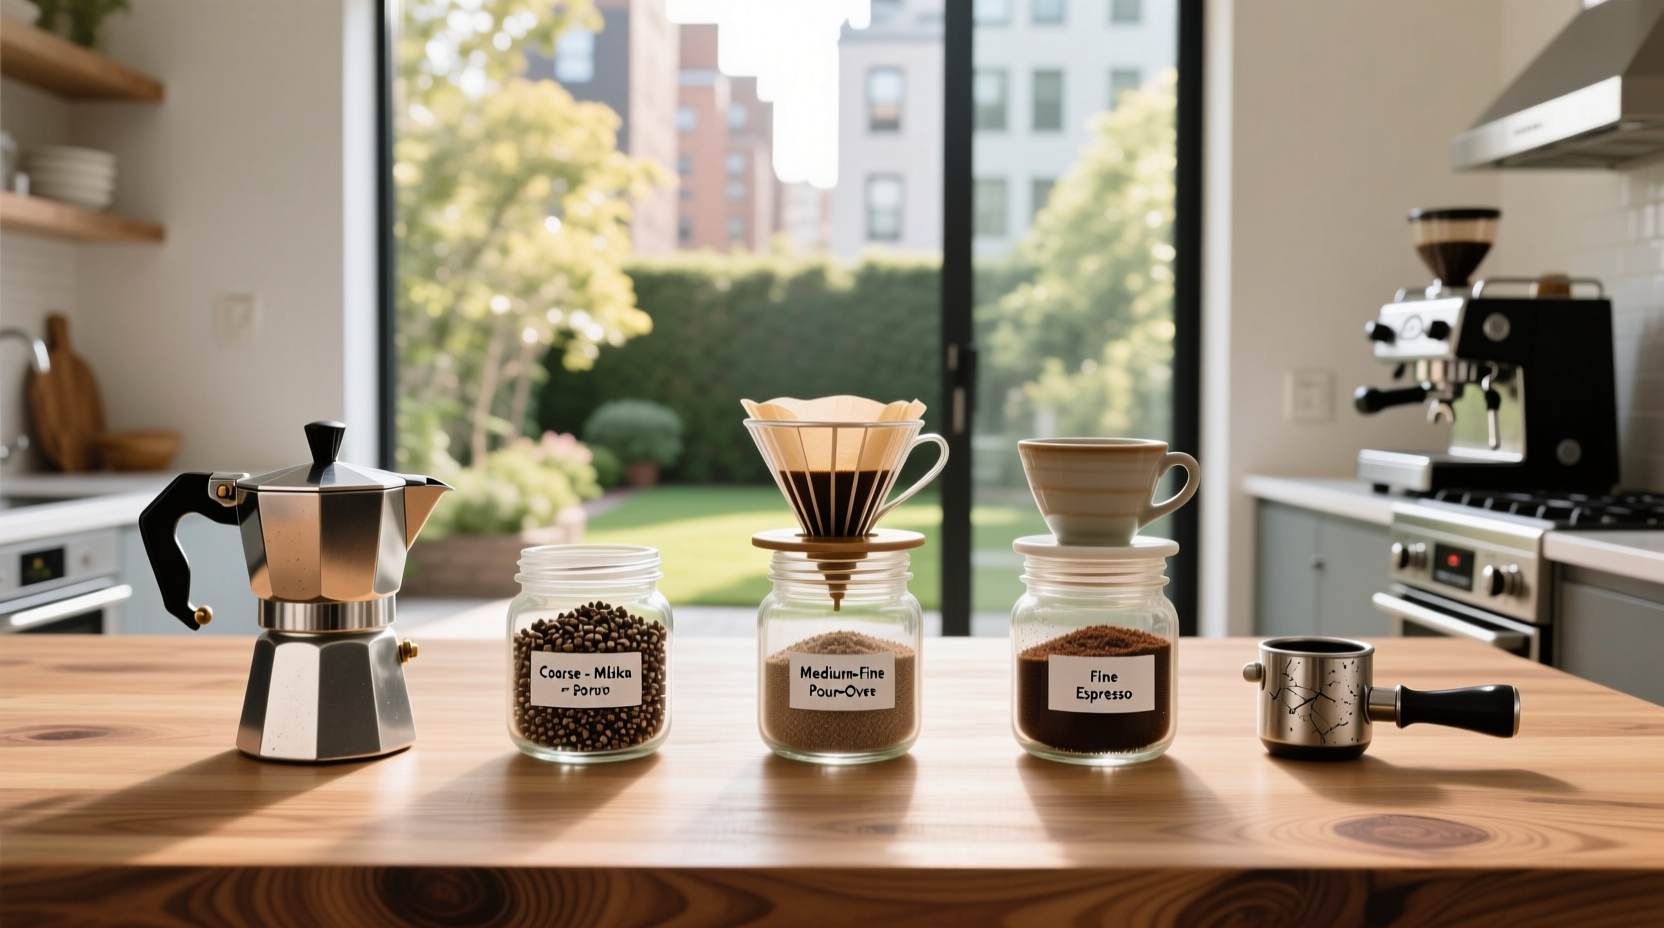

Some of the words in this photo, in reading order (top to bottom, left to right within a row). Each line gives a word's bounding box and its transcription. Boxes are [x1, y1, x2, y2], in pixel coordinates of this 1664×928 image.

[800, 665, 885, 680] Medium-Fine
[1090, 669, 1118, 683] Fine
[1076, 686, 1133, 704] Espresso
